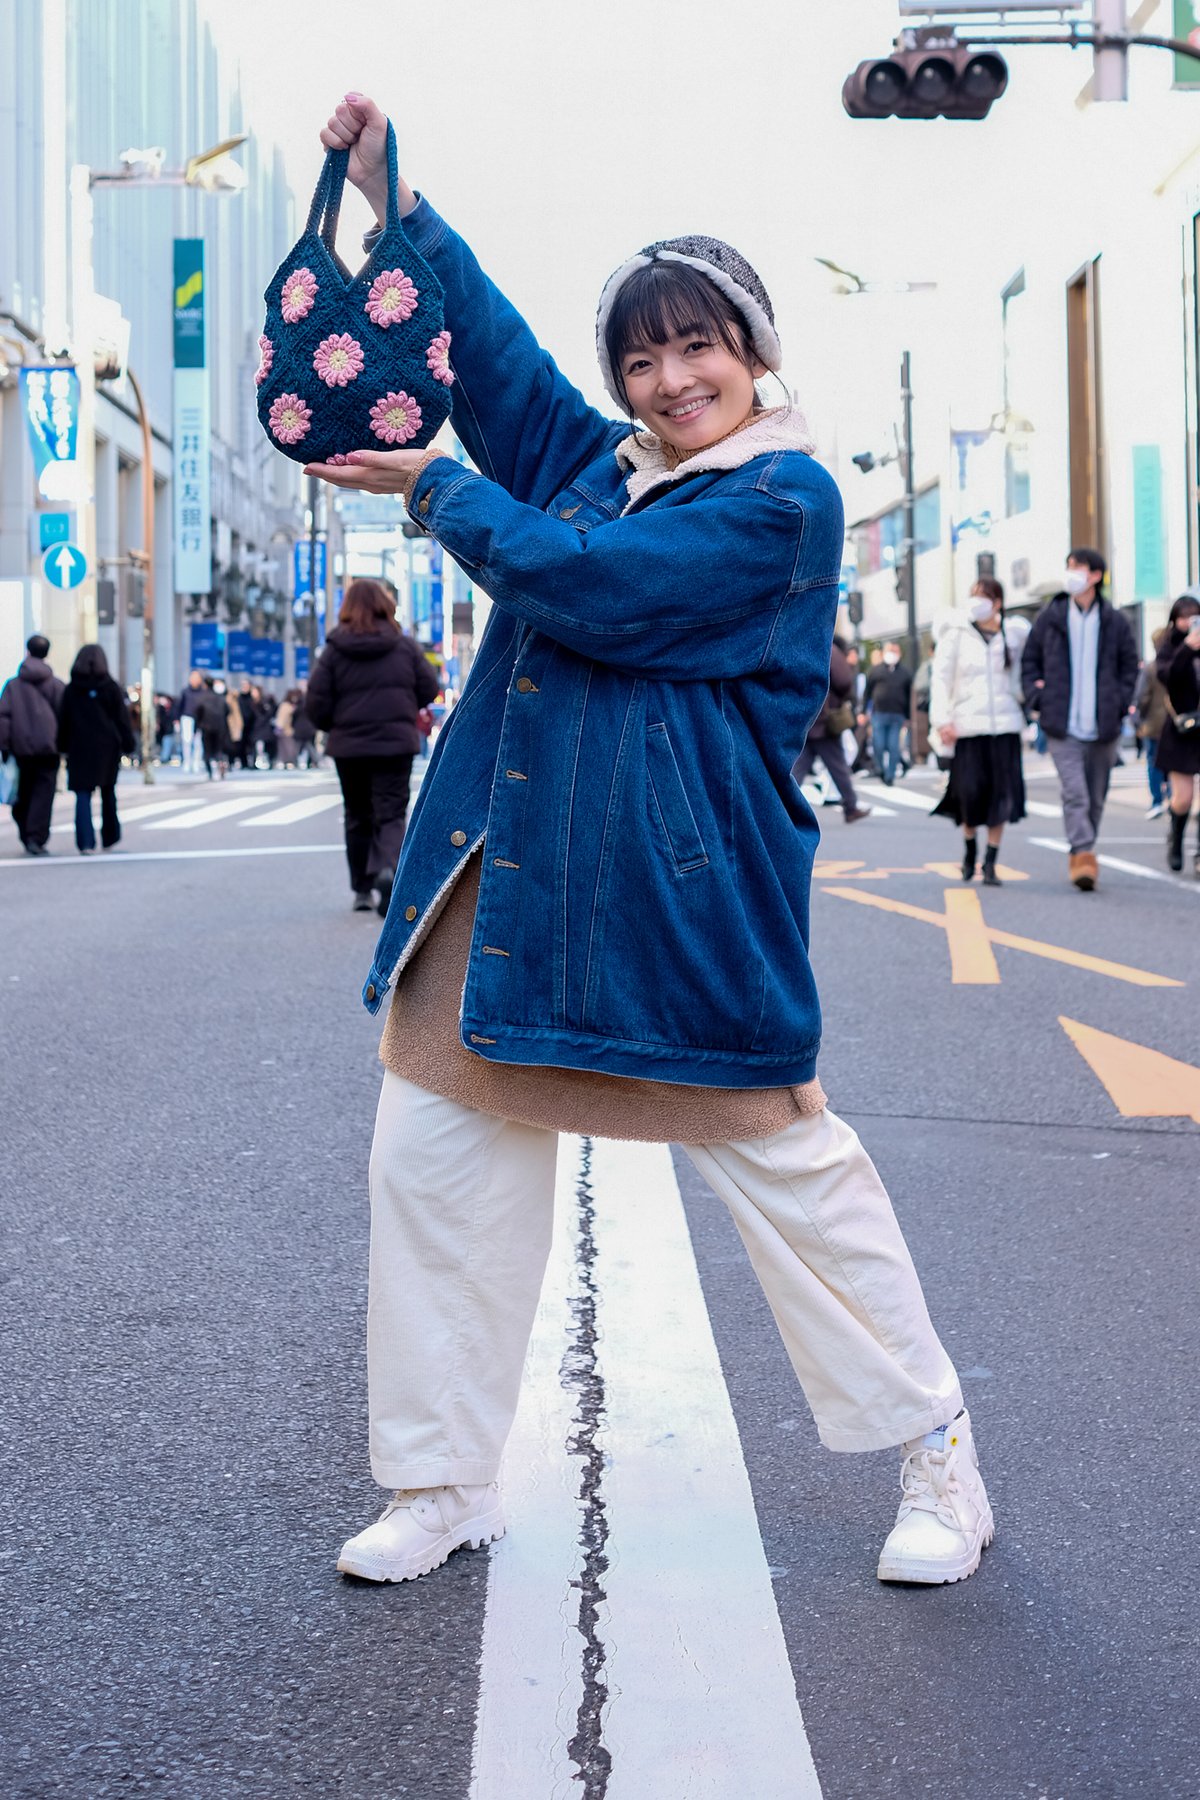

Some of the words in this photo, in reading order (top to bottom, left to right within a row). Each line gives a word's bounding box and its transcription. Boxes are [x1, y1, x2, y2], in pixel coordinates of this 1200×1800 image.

[180, 407, 202, 552] 三井住友銀行
